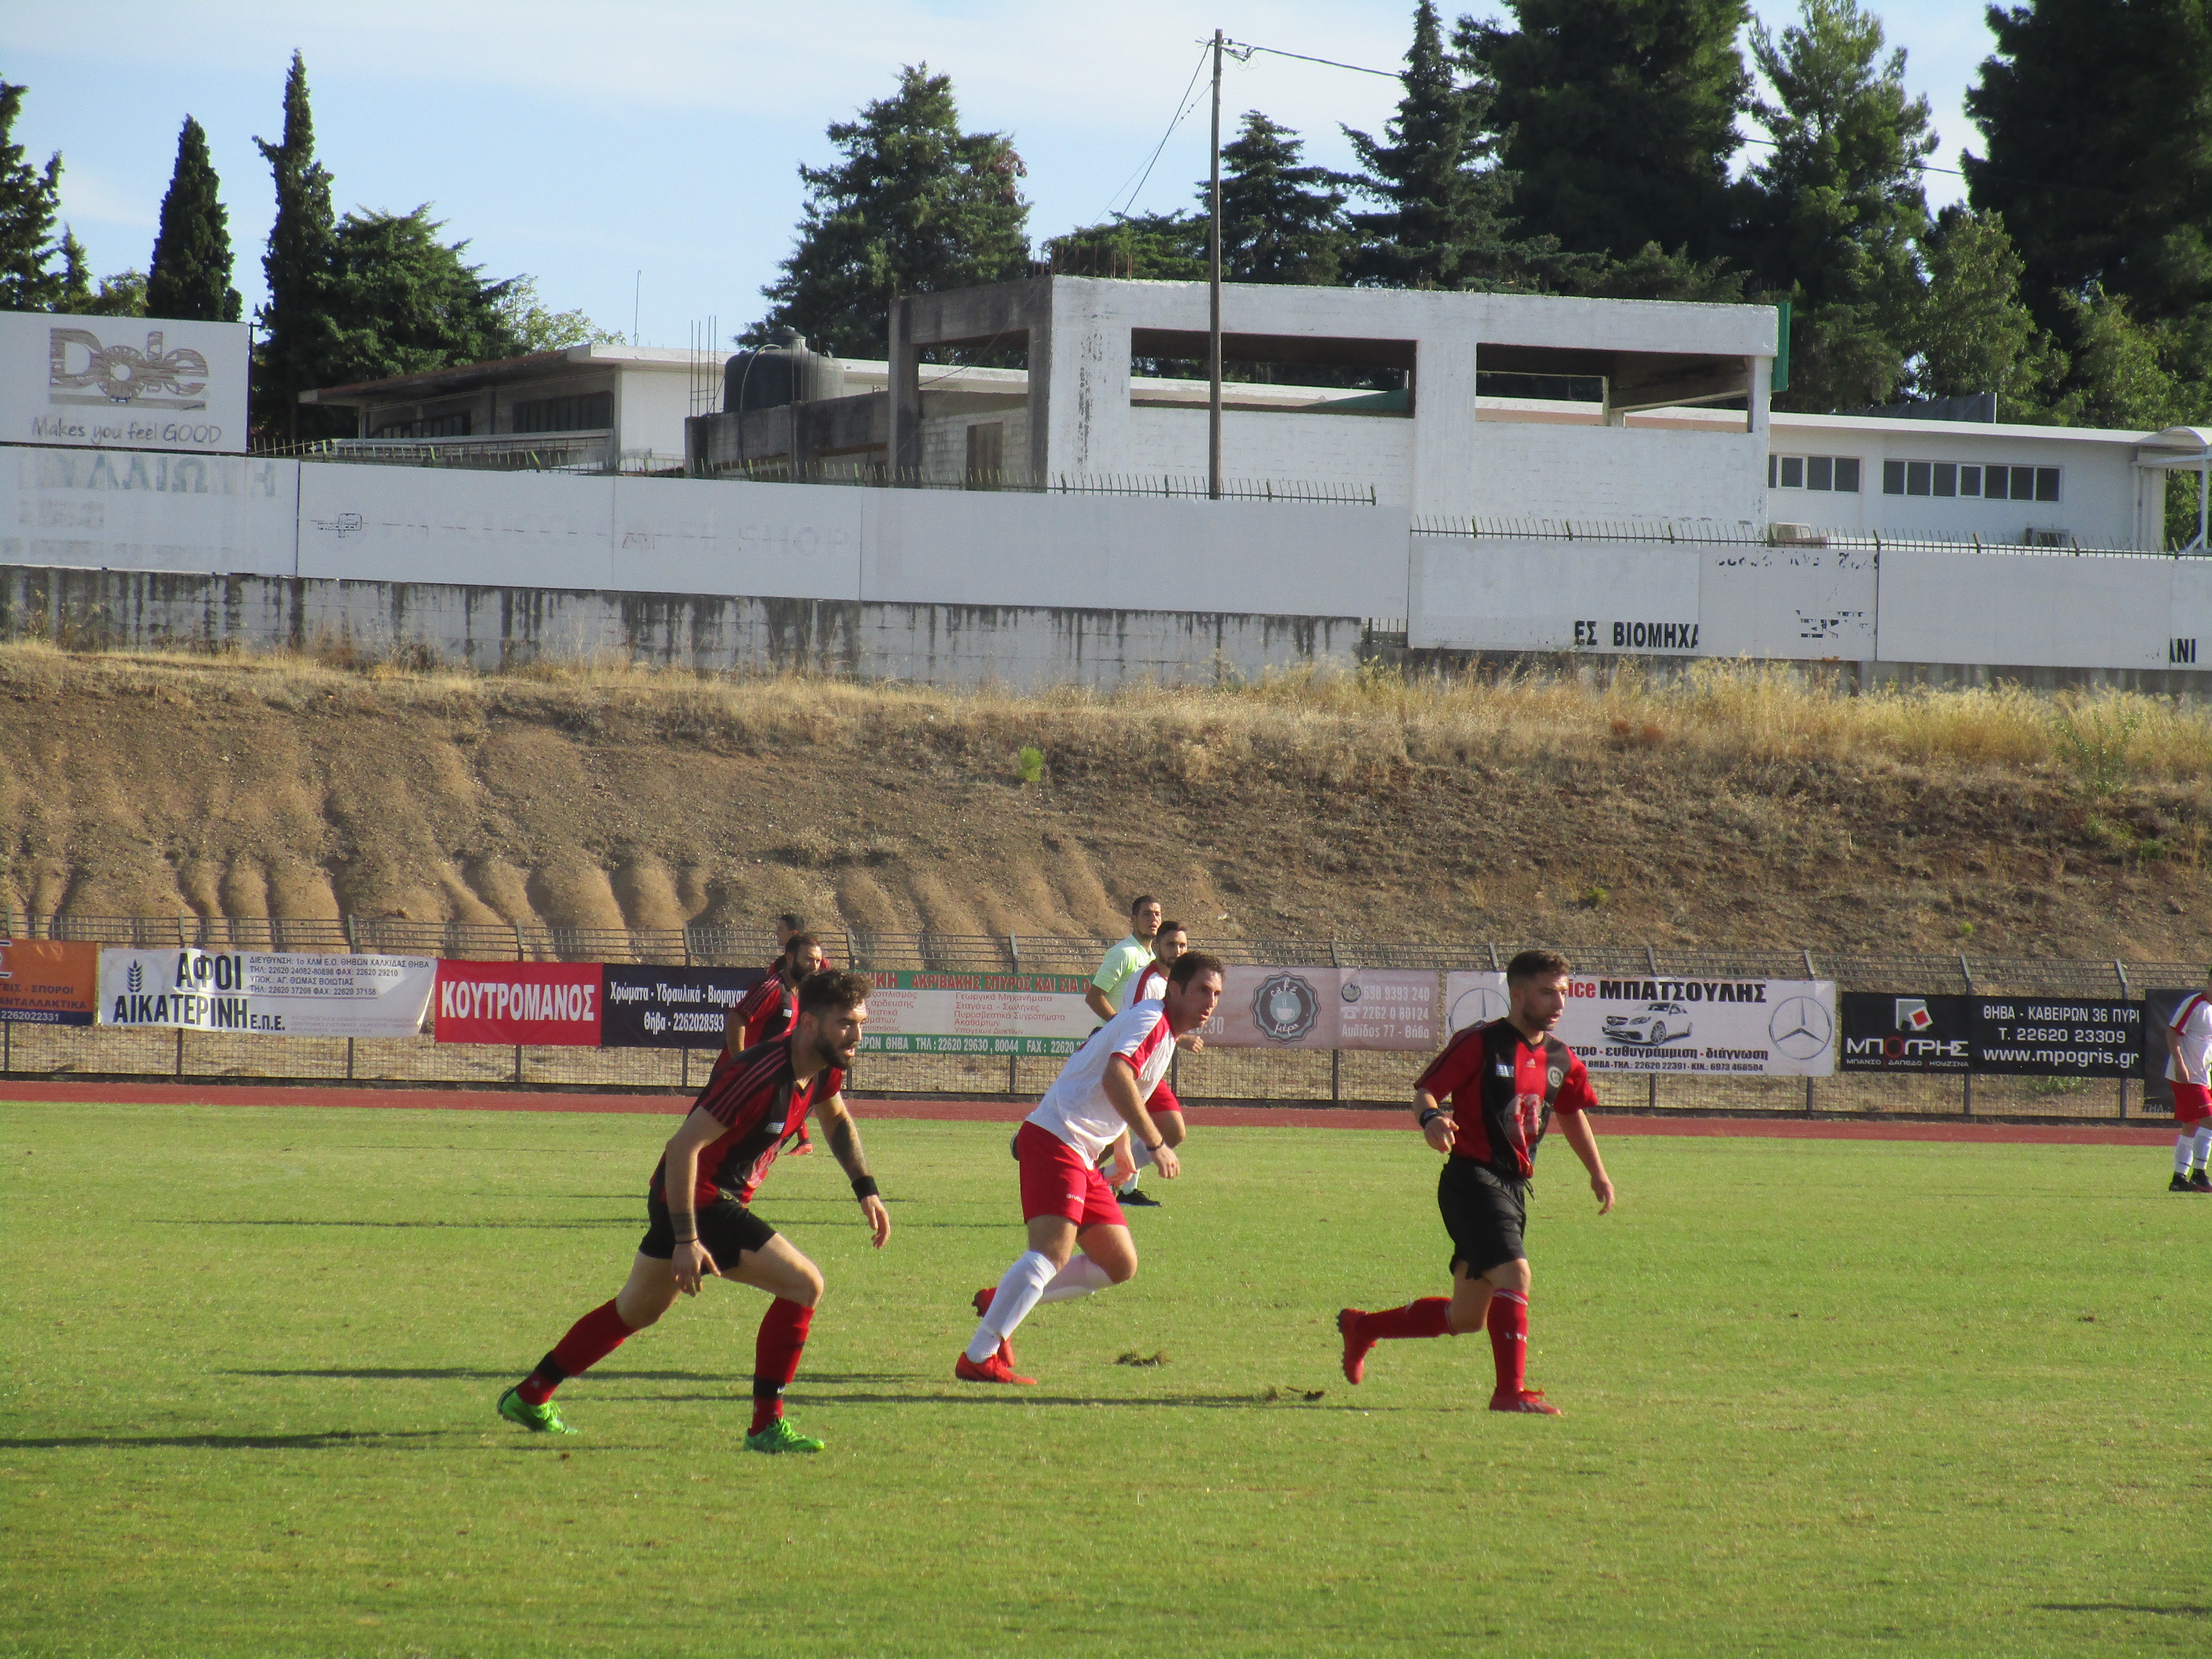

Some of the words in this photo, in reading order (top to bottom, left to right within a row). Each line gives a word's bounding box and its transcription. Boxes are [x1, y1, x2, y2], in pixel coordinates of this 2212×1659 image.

[50, 327, 209, 399] Dole
[32, 417, 85, 438] Makes
[91, 425, 122, 446] you
[127, 422, 157, 440] feel
[163, 423, 222, 444] GOOD
[176, 953, 241, 990] ΑΦΟΙ
[356, 968, 376, 976] 22620
[31, 985, 74, 994] ΣΠΟΡΟΙ
[269, 985, 289, 994] 22620
[333, 987, 354, 996] 22620
[911, 974, 981, 990] ΑΚΡΙΒΑΚΗΣ
[985, 975, 1031, 991] ΣΠΥΡΟΣ
[1035, 977, 1056, 992] ΚΑΙ
[1059, 978, 1079, 993] ΣΙΑ
[1568, 979, 1596, 998] ice
[1600, 980, 1767, 1003] ΜΠΑΤΣΟΥΛΗΣ
[441, 981, 595, 1021] ΚΟΥΤΡΟΜΑΝΟΣ
[610, 981, 649, 1005] Χρώματα
[656, 982, 700, 1007] Υδραυλικά
[708, 984, 749, 1008] Βιομηχαν
[956, 993, 996, 1001] Γεωργικά
[999, 993, 1052, 1002] Μηχανήματα
[1412, 987, 1430, 1001] 240
[1, 1010, 59, 1022] 2262022331
[113, 994, 247, 1028] ΑΙΚΑΤΕΡΙΝΗ
[250, 1014, 285, 1031] Ε.Π.Ε.
[954, 1011, 1011, 1020] Πυροσβεστικά
[1003, 1003, 1039, 1013] Σωλήνες
[1362, 1006, 1386, 1019] 2262
[1399, 1007, 1429, 1021] 80124
[1983, 1005, 2016, 1020] ΘΗΒΑ
[2028, 1006, 2088, 1022] ΚΑΒΕΙΡΩΝ
[2093, 1008, 2108, 1022] 36
[2113, 1008, 2140, 1024] ΠΥΡΙ
[644, 1011, 666, 1035] Θήβα
[672, 1012, 724, 1033] 2262028593
[954, 1019, 1000, 1027] Ακαθάρτων
[1383, 1024, 1395, 1037] 77
[2017, 1028, 2068, 1042] 22620
[2075, 1029, 2125, 1044] 23309
[886, 1037, 909, 1050] ΘΗΒΑ
[938, 1037, 962, 1051] 22620
[995, 1039, 1019, 1052] 80044
[1051, 1041, 1074, 1054] 22620
[1605, 1045, 1698, 1060] ευθυγράμμιση
[1705, 1047, 1769, 1061] διάγνωση
[1847, 1036, 1969, 1059] ΜΠΟΓΡΗΣ
[1635, 1061, 1661, 1070] 22620
[1983, 1047, 2139, 1068] www.mpogris.gr
